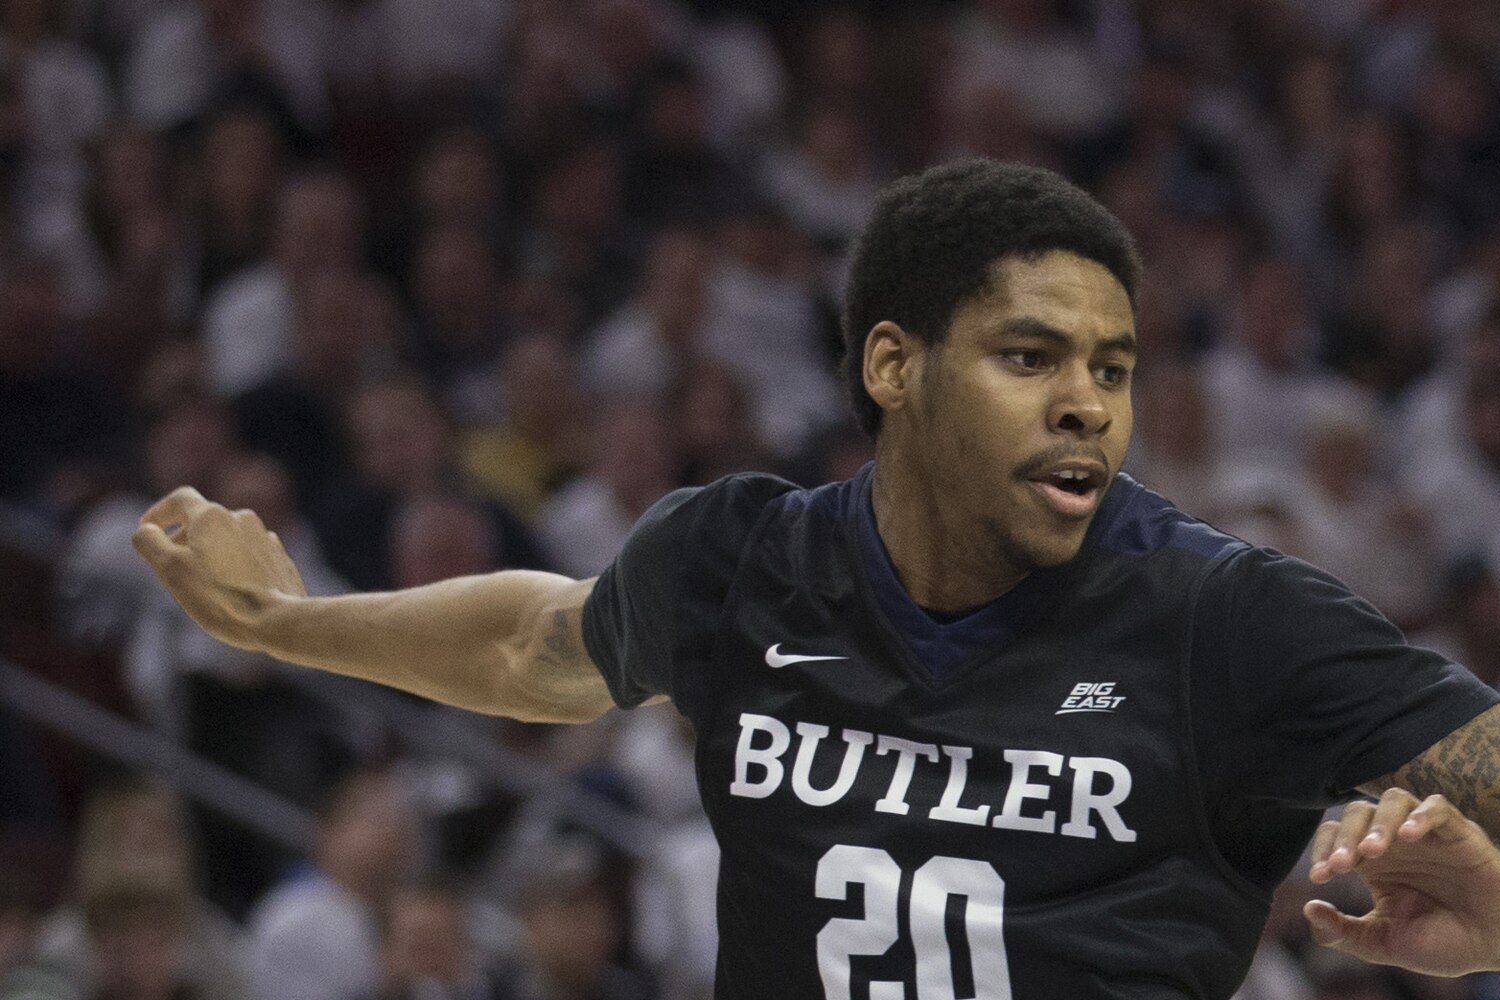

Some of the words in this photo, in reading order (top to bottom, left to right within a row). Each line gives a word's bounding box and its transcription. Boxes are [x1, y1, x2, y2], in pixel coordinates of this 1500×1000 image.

[1069, 682, 1117, 696] BIG
[1060, 696, 1127, 709] EAST
[729, 712, 1138, 842] BUTLER
